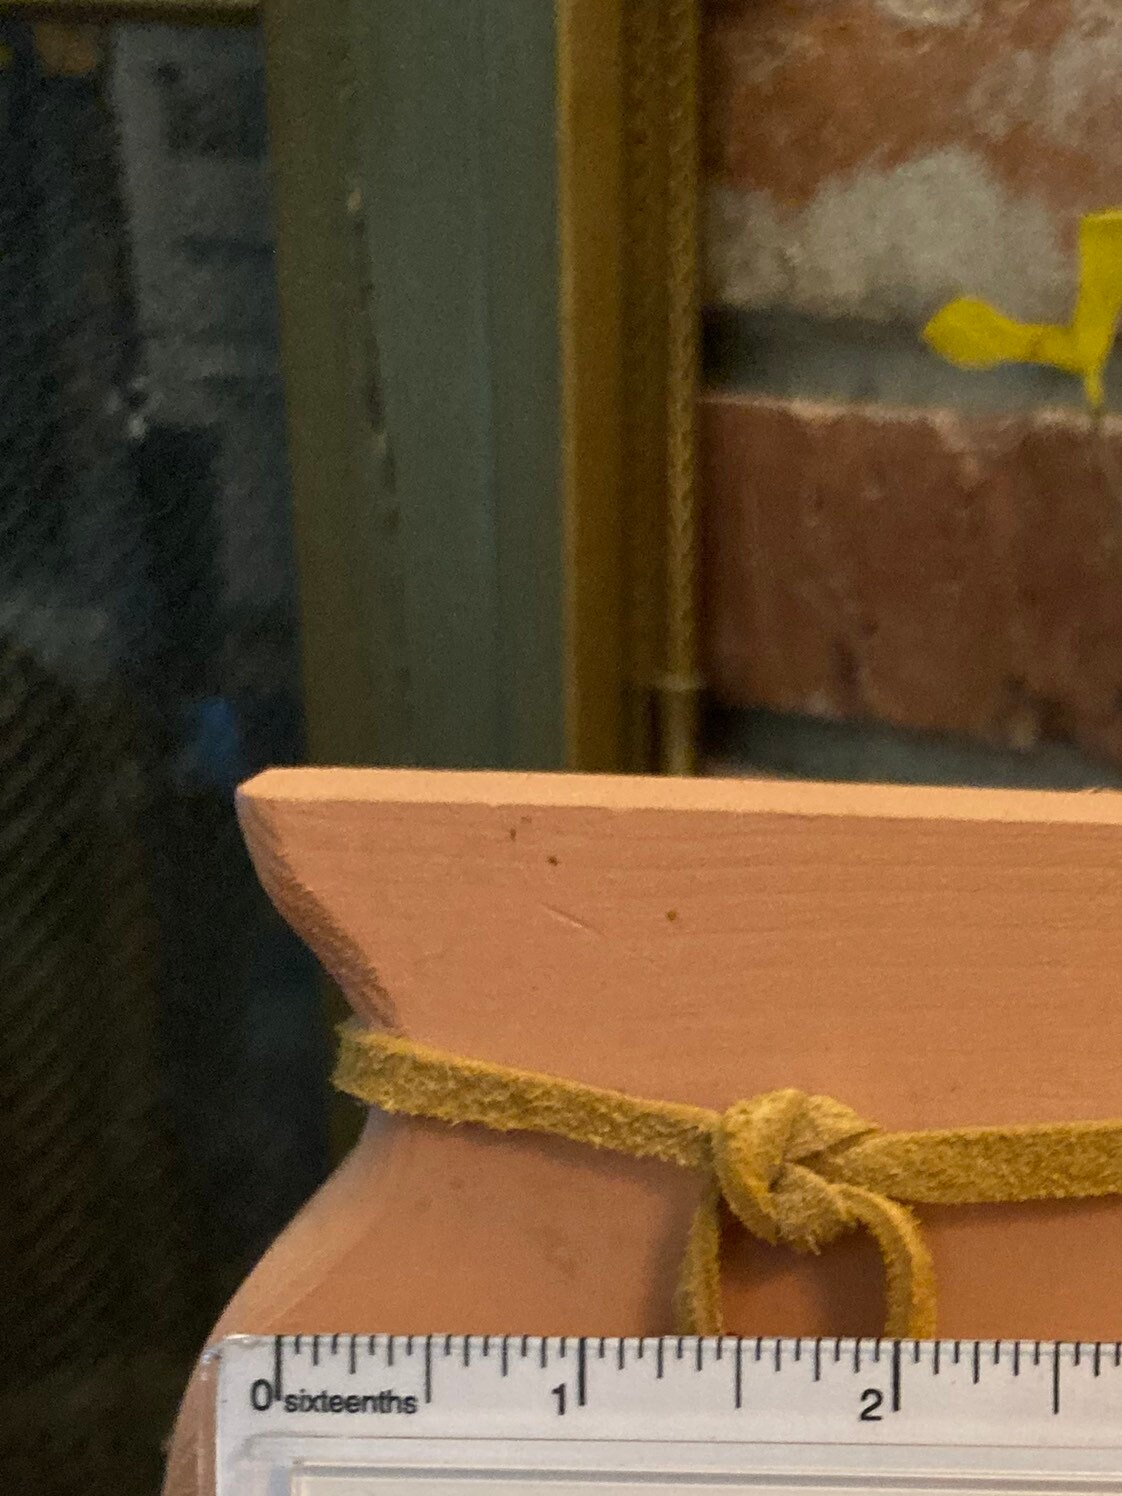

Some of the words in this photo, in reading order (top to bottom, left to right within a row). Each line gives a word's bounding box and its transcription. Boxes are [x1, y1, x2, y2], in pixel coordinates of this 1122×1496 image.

[250, 1379, 272, 1411] 0
[283, 1390, 419, 1415] sixteenths
[551, 1383, 567, 1415] 1
[860, 1389, 884, 1421] 2
